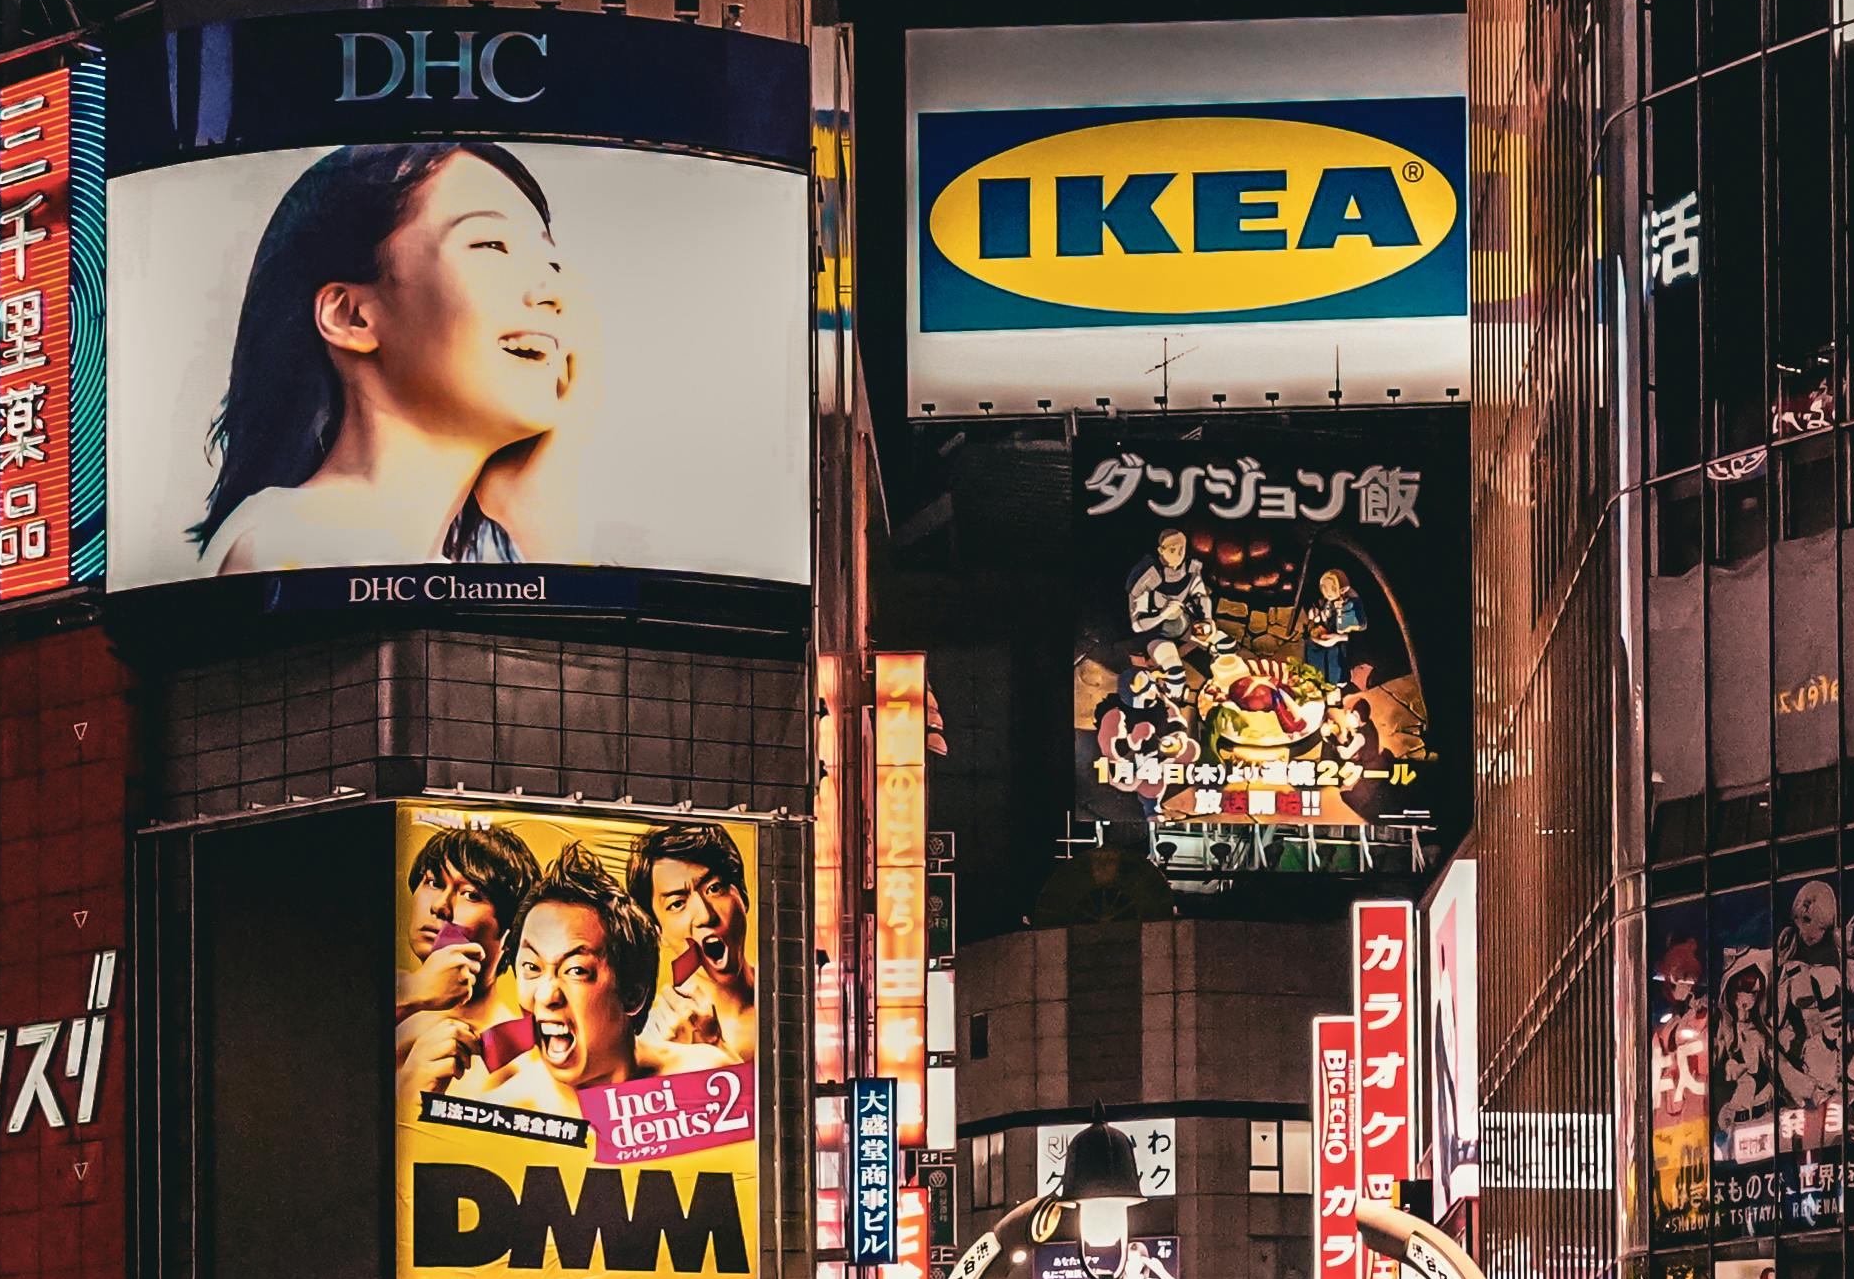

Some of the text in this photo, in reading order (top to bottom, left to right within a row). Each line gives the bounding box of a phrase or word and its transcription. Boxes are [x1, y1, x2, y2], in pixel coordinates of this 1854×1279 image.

[334, 30, 550, 103] DHC
[979, 166, 1420, 260] IKEA
[1083, 451, 1424, 531] ダンジョン飯
[348, 573, 548, 603] DHC Channel
[1361, 933, 1406, 1148] カラオケ
[603, 1079, 678, 1122] Inci
[1323, 1049, 1349, 1165] BIG ECHO
[413, 1163, 749, 1274] DMM
[859, 1089, 888, 1255] 大盛堂商事ビル
